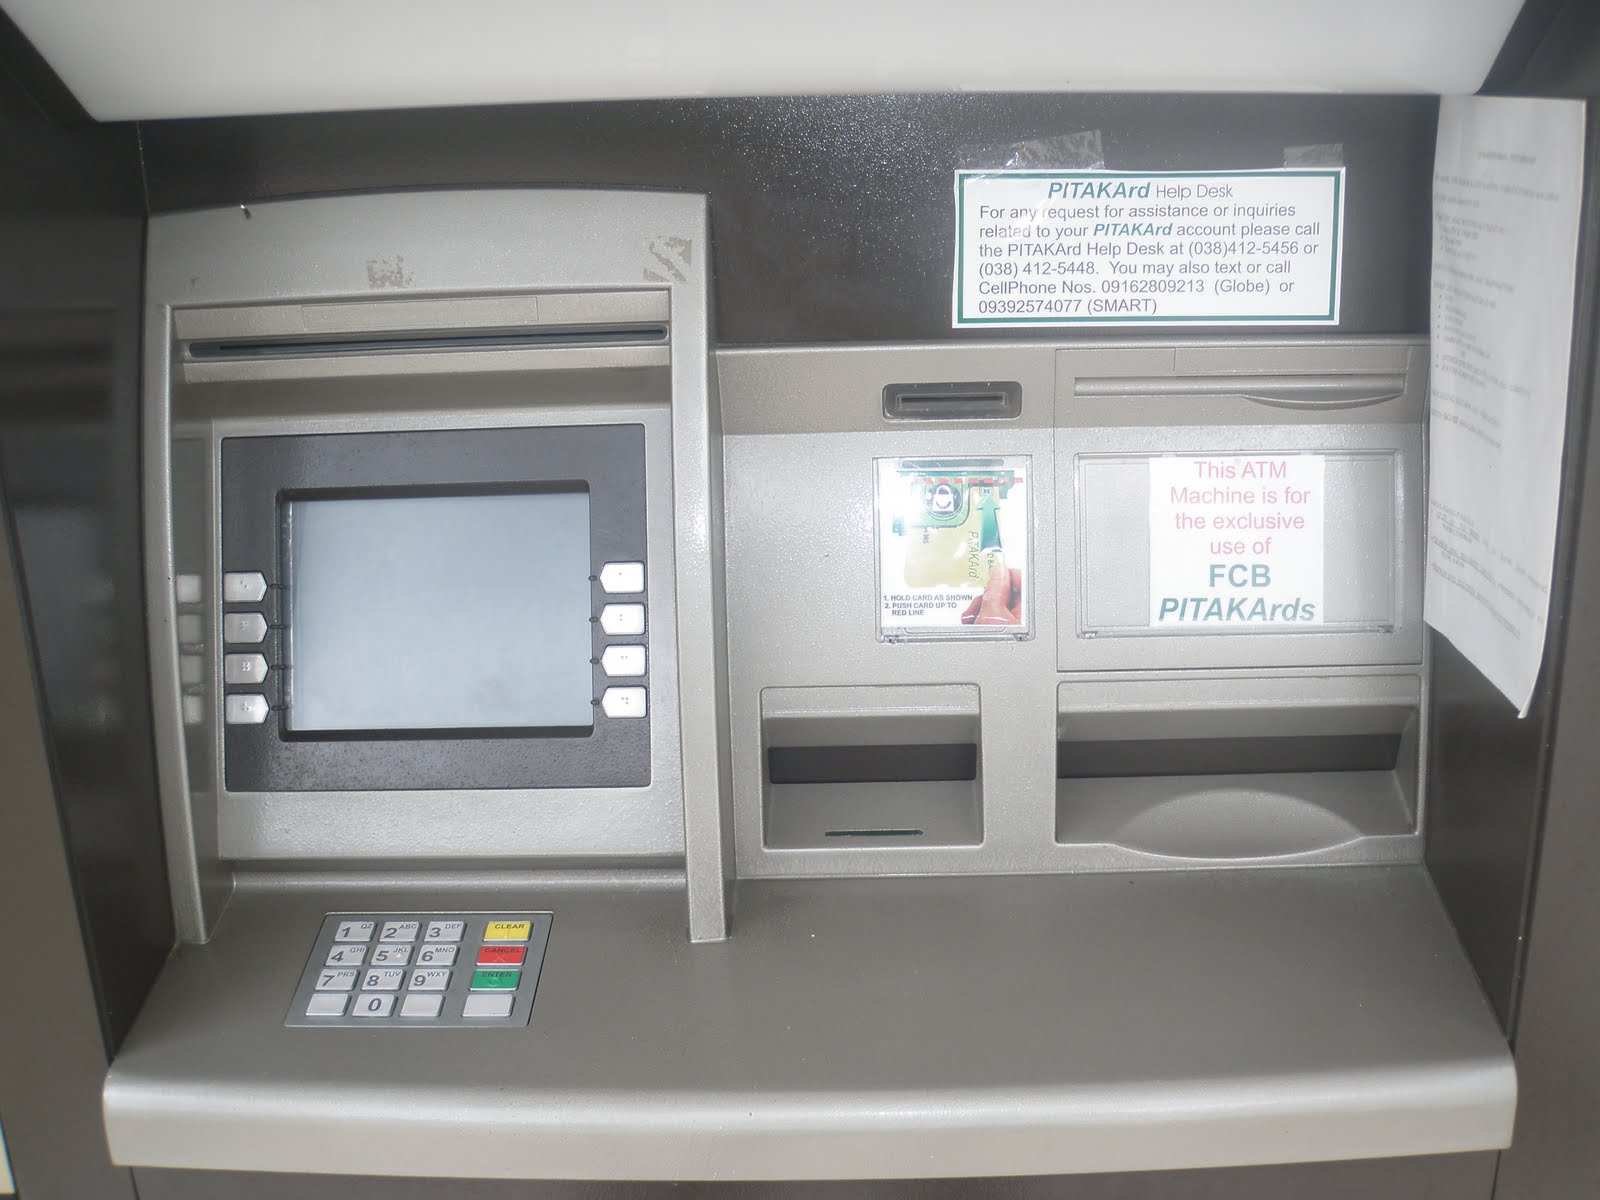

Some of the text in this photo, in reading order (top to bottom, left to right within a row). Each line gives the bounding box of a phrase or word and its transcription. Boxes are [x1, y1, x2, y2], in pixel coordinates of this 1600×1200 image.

[1048, 182, 1233, 201] PITAKArd Help Desk
[980, 203, 1296, 222] For any request for assistance or inquiries
[979, 221, 1320, 241] related to your PITAKArd account please call
[979, 240, 1319, 259] the PITAKArd Help Desk at (038)412-5456 or
[979, 260, 1292, 279] (038) 412-5448. You may also text or call
[978, 278, 1295, 296] CellPhone Nos. 09162809213 (Globe) or
[978, 298, 1158, 315] 09392574077 (SMART)
[1194, 461, 1287, 479] This ATM
[1170, 486, 1311, 505] Machine is for
[1175, 511, 1305, 530] the exclusive
[1210, 537, 1272, 555] use of
[1209, 564, 1272, 588] FCB
[890, 594, 911, 602] HOLD
[912, 594, 933, 602] CARD
[1158, 597, 1316, 622] PITAKArds
[342, 926, 351, 938] 1
[384, 927, 398, 938] 2
[429, 927, 441, 938] 3
[331, 950, 344, 962] 4
[375, 950, 389, 962] 5
[421, 951, 434, 962] 6
[322, 975, 335, 987] 7
[366, 975, 380, 986] 8
[413, 975, 427, 987] 9
[367, 998, 382, 1012] 0
